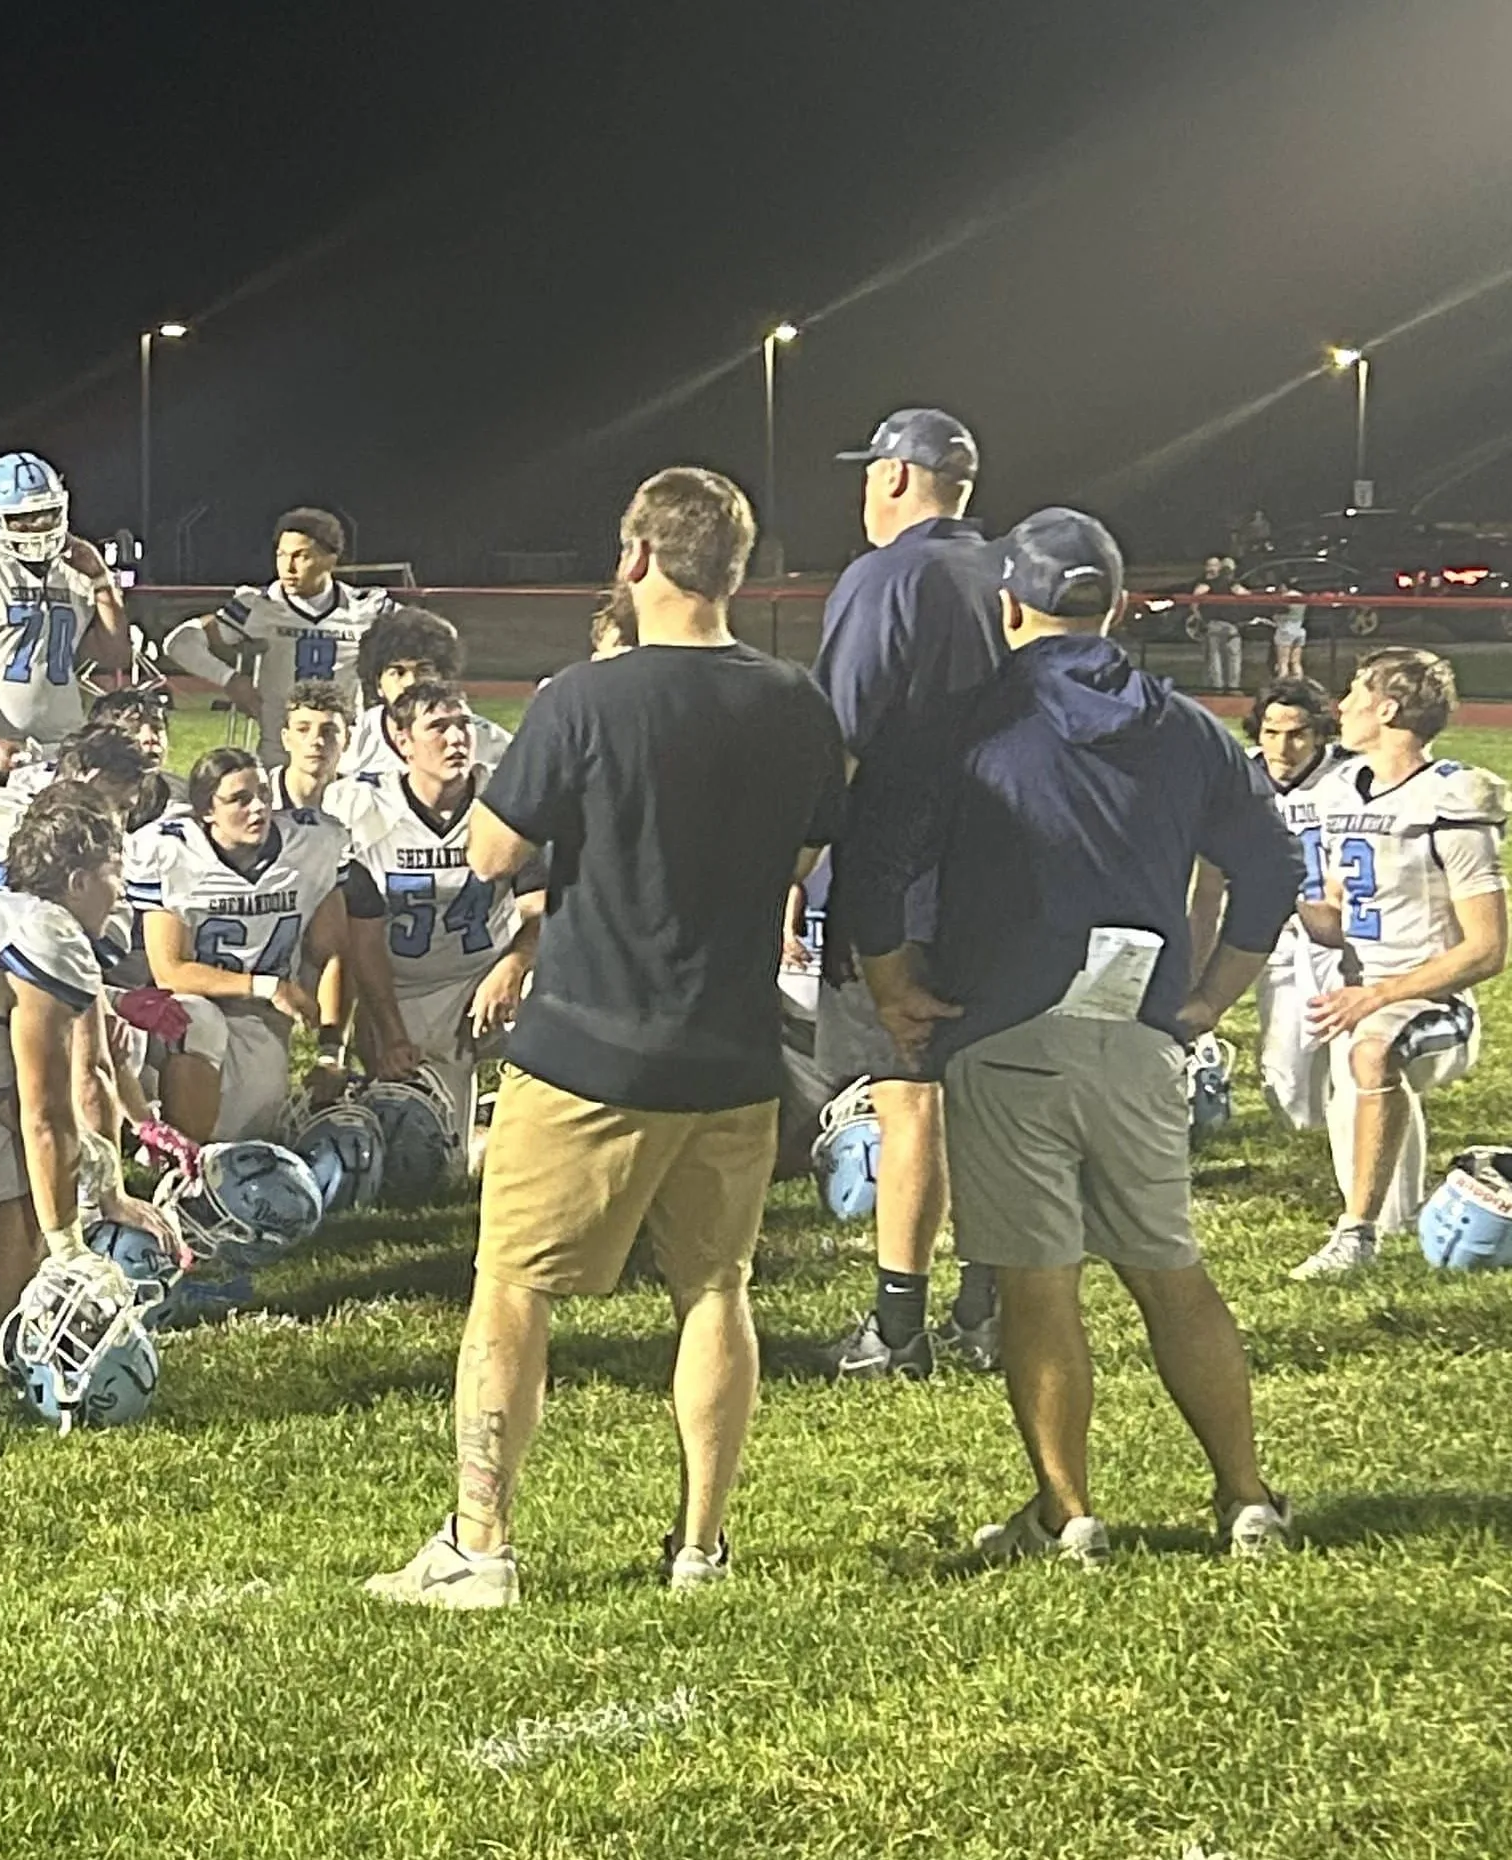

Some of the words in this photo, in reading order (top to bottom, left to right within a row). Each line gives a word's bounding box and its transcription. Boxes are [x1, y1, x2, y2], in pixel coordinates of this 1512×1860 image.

[3, 604, 77, 686] 70
[295, 637, 337, 682] 8
[385, 870, 494, 959] 54
[1340, 837, 1383, 942] 2
[195, 914, 302, 978] 64
